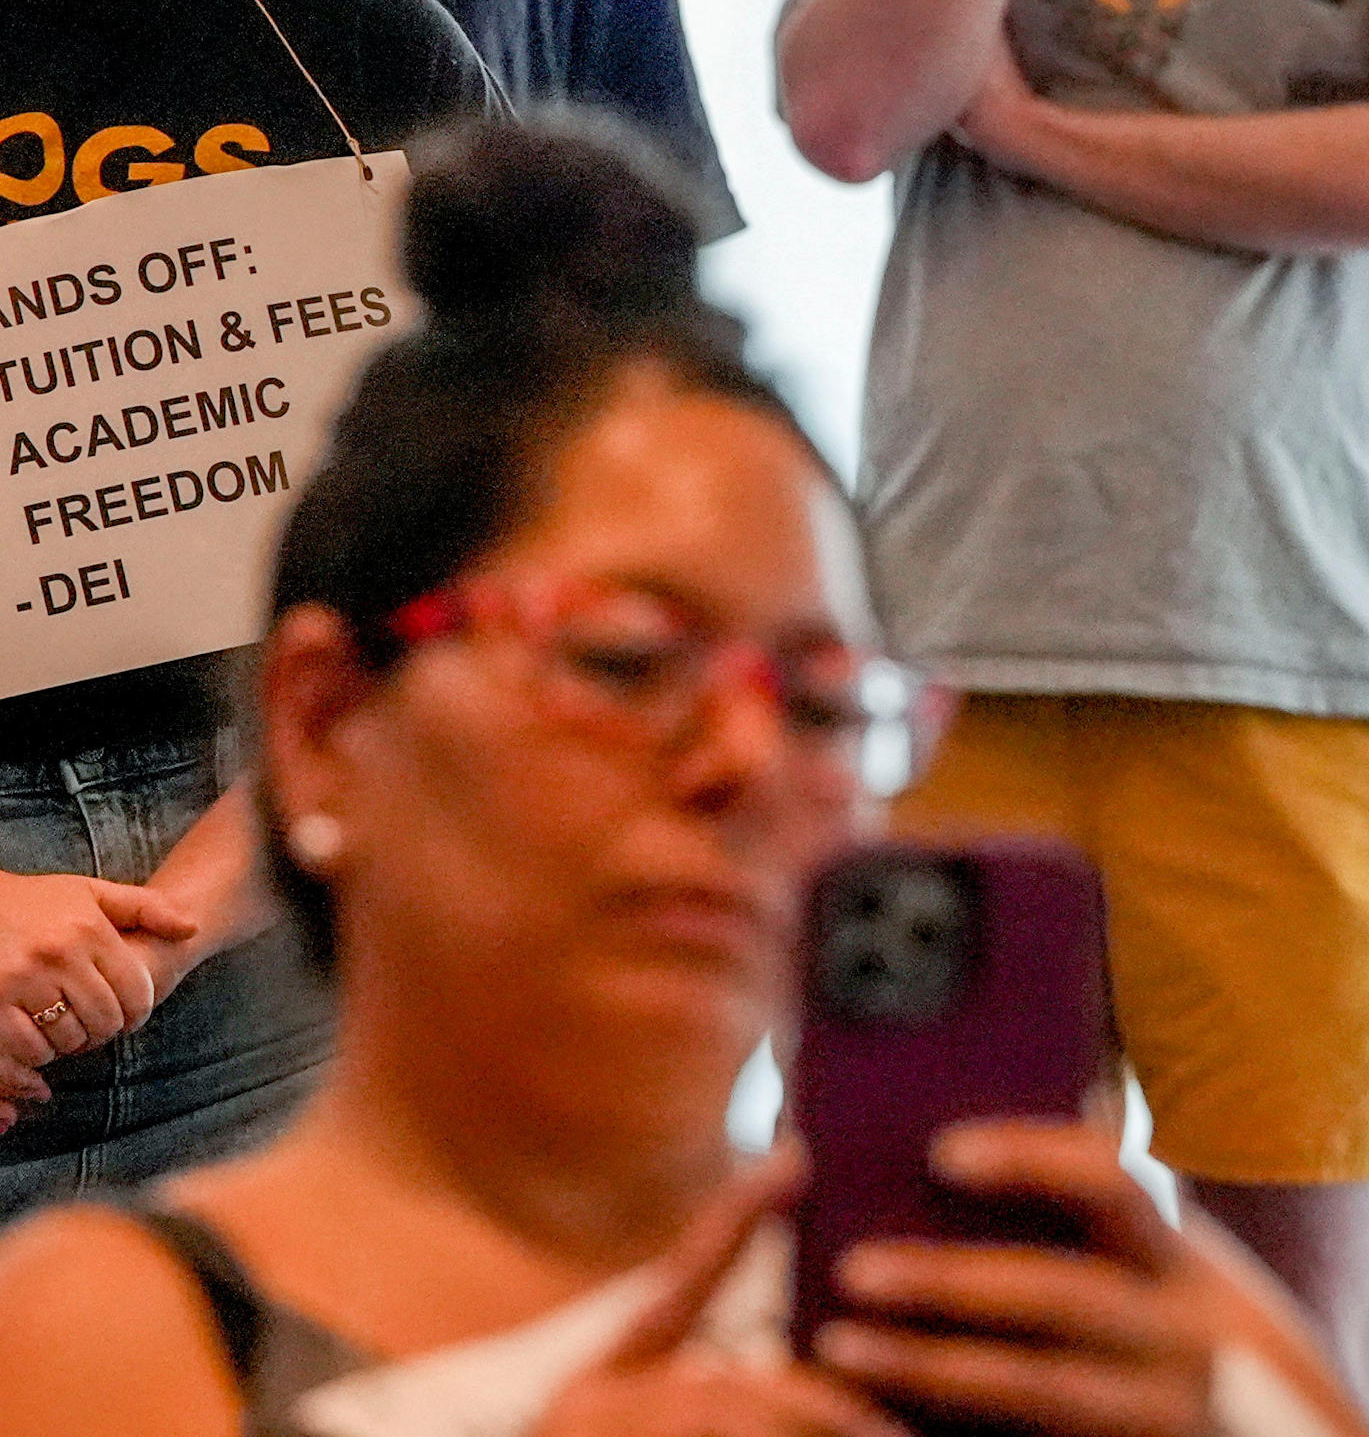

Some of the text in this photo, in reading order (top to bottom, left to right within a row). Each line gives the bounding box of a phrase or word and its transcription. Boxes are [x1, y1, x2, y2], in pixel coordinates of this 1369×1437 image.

[137, 237, 258, 294] OFF:
[220, 310, 257, 353] &
[266, 287, 392, 344] FEES
[23, 450, 290, 545] FREEDOM
